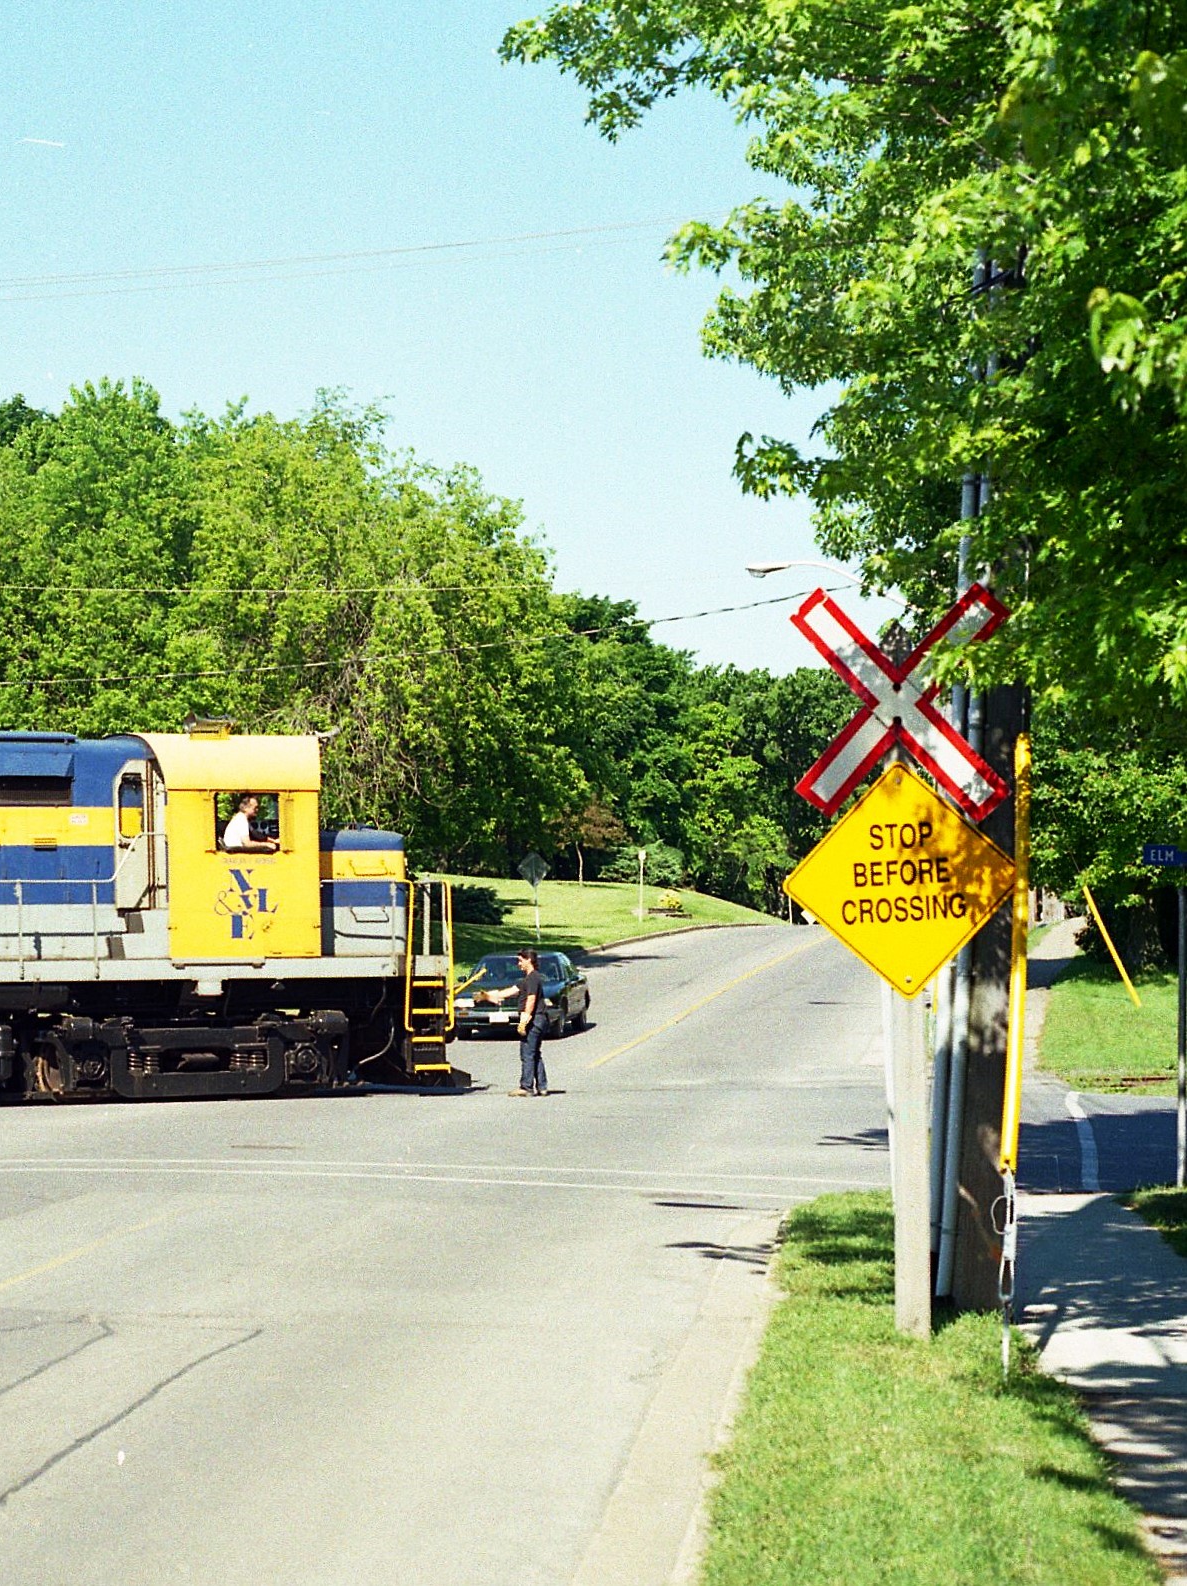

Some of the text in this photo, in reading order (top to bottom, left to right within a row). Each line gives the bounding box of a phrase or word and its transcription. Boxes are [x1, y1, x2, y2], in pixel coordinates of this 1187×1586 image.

[869, 820, 933, 851] STOP
[1150, 849, 1175, 862] ELM
[853, 856, 951, 888] BEFORE
[841, 892, 967, 926] CROSSING
